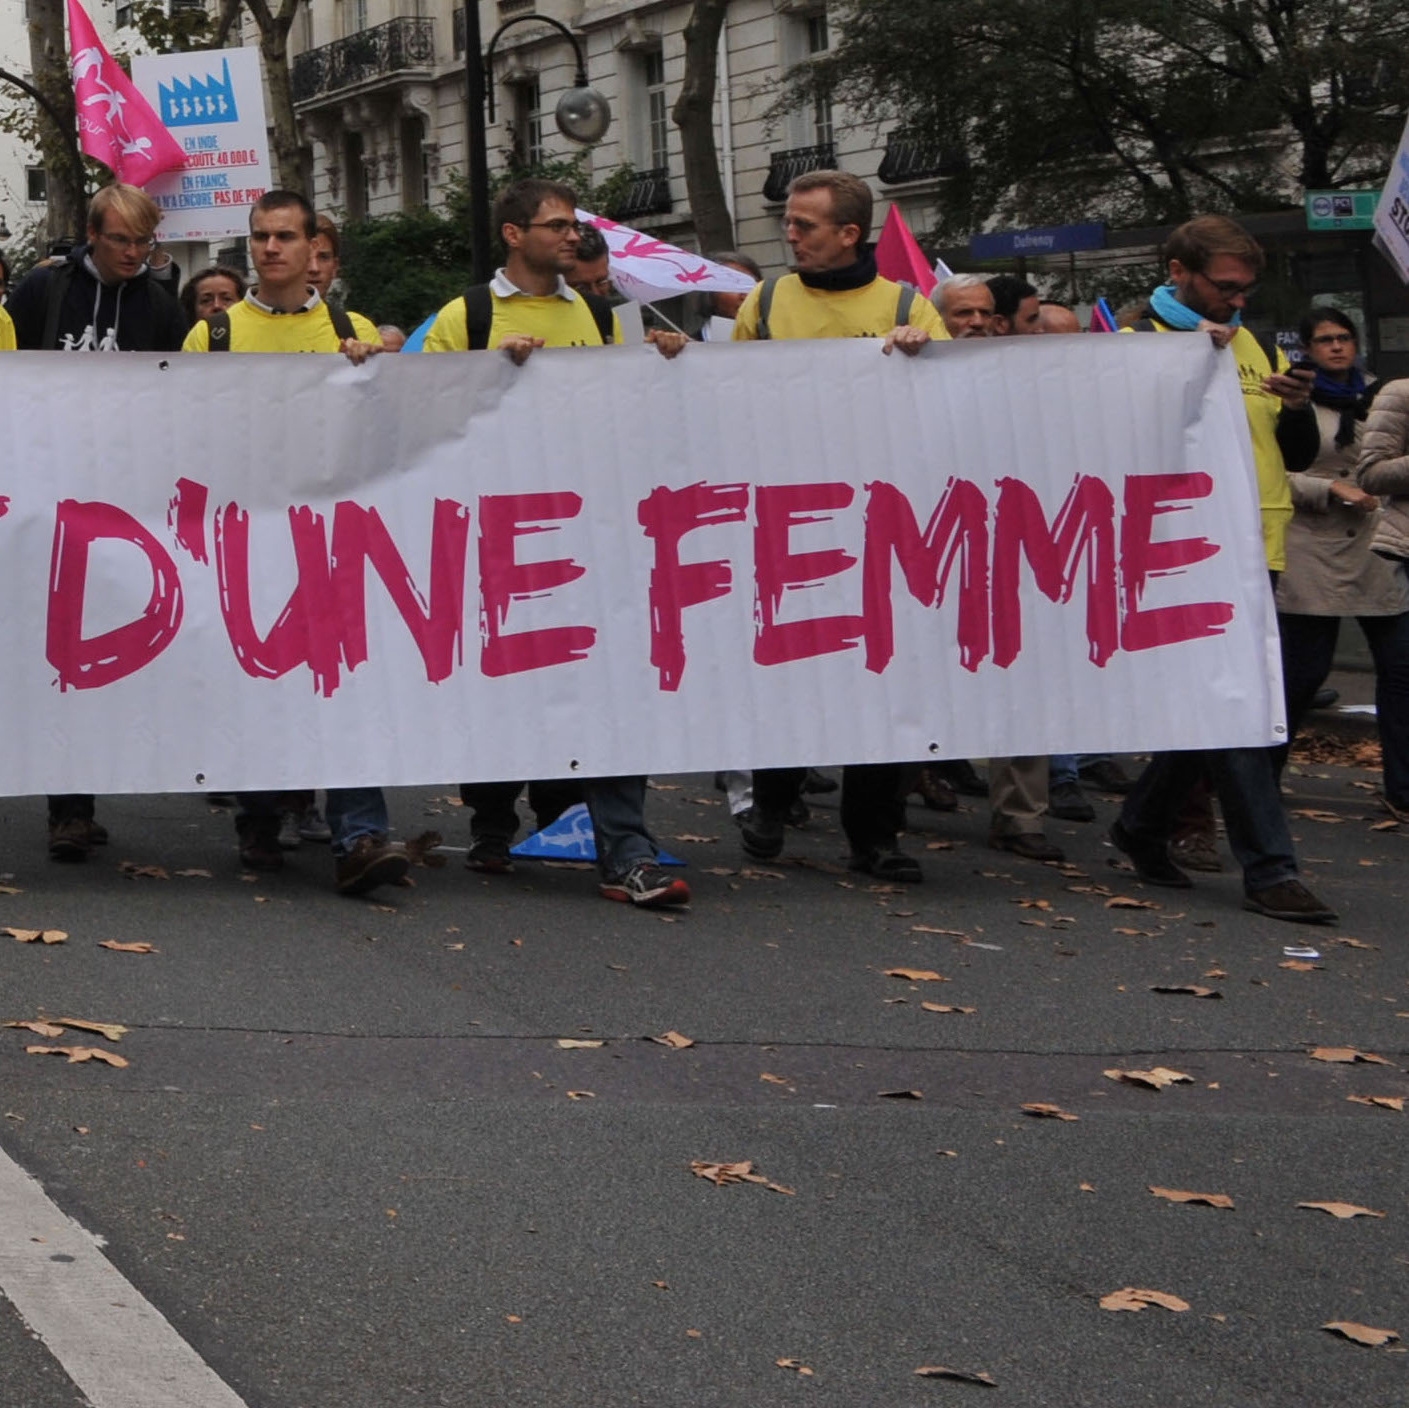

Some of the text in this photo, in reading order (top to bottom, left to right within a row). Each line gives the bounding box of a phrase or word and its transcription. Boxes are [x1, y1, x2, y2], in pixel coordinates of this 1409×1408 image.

[184, 135, 218, 151] EN INDE
[217, 151, 229, 165] 40
[230, 150, 248, 164] 000
[181, 173, 228, 190] EN FRANCE
[179, 192, 213, 207] ENCORE
[214, 190, 231, 204] PAS
[232, 189, 244, 203] DE
[47, 478, 596, 698] D'UNE
[638, 472, 1233, 691] FEMME
